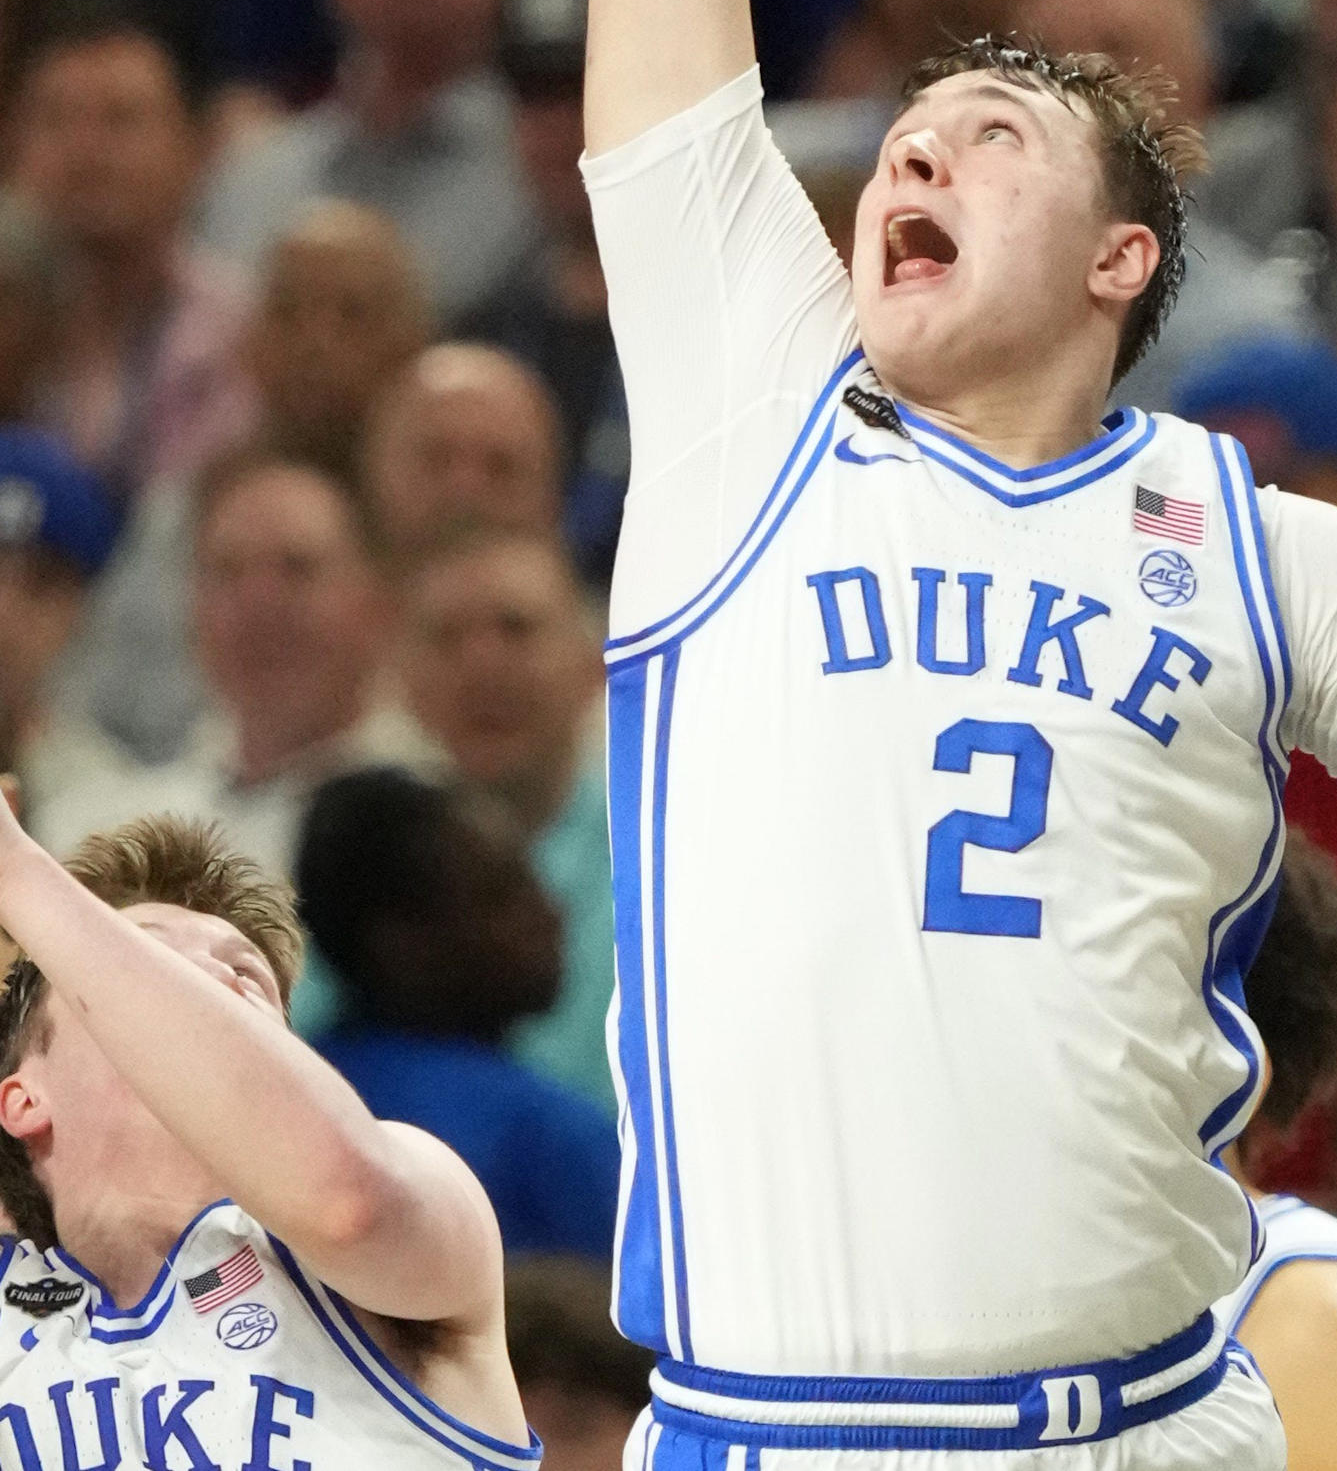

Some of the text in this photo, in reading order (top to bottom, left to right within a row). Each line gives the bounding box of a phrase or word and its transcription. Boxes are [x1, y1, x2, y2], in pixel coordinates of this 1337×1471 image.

[847, 390, 882, 414] FINAL
[1145, 568, 1194, 586] ACC
[806, 566, 1213, 748] DUKE
[922, 717, 1054, 939] 2
[9, 1287, 83, 1303] FINAL FOUR
[226, 1308, 270, 1336] ACC
[1039, 1374, 1102, 1441] D
